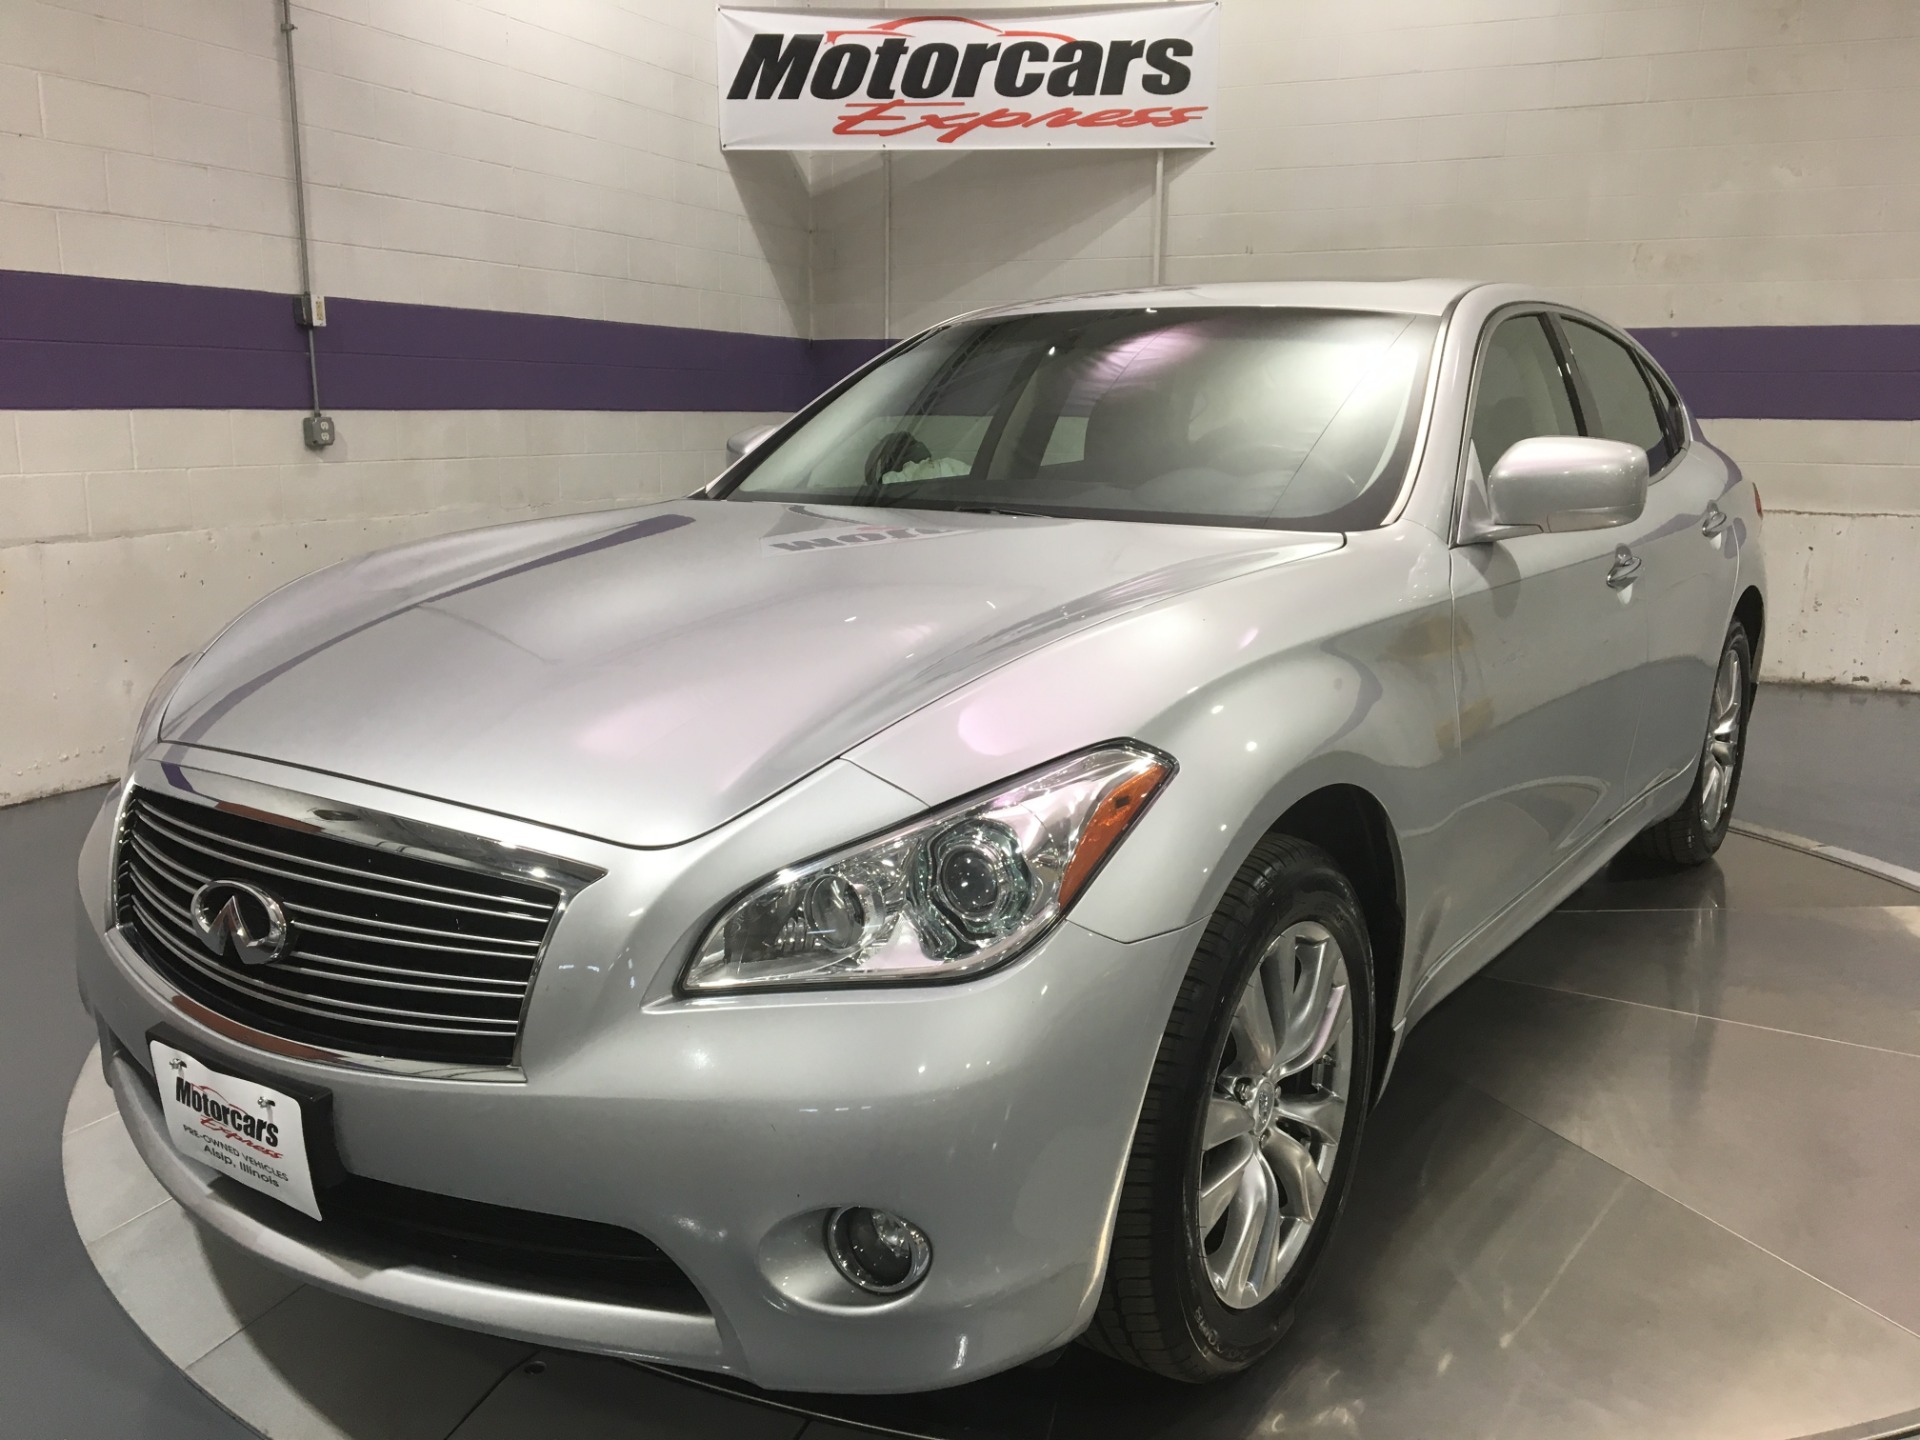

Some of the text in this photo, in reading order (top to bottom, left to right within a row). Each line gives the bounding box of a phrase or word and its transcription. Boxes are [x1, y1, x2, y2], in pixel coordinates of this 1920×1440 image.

[727, 33, 1194, 100] Motorcars
[832, 99, 1208, 143] Express
[176, 1076, 279, 1148] Motorcars
[200, 1114, 284, 1159] Express
[183, 1123, 289, 1182] PRE-OWNED VEHICLES
[203, 1144, 280, 1188] Alsip, Illinois
